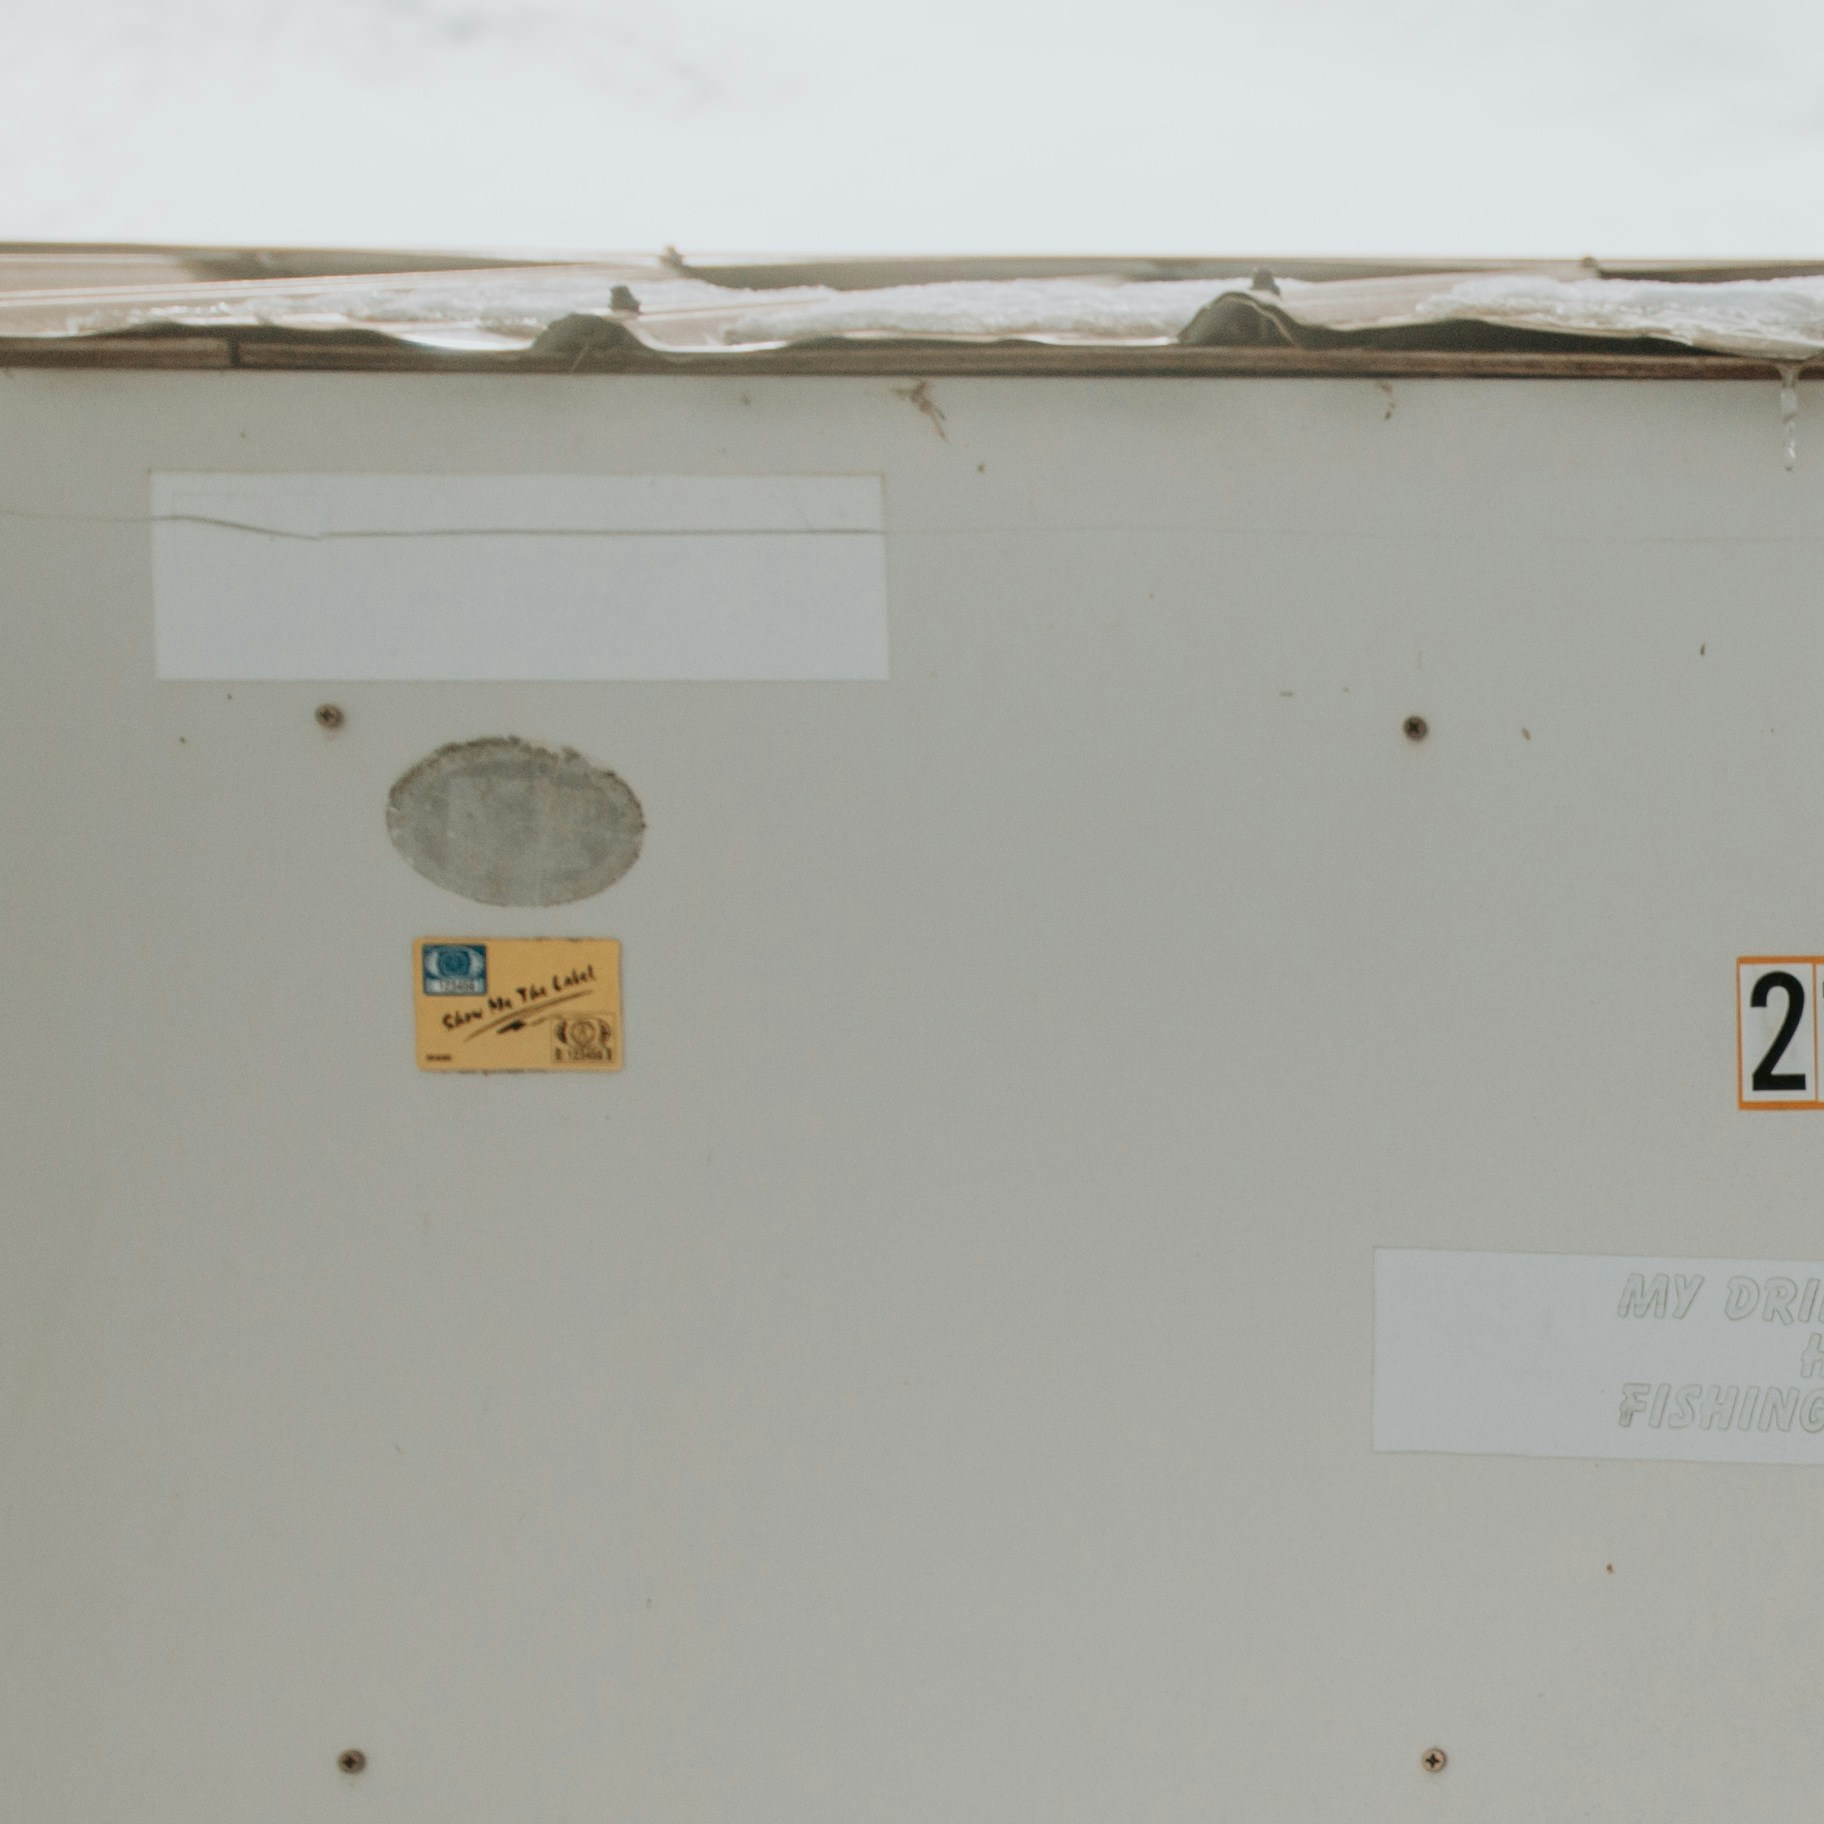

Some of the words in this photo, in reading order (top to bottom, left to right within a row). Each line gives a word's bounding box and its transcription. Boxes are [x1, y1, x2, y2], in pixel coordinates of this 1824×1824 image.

[442, 1011, 482, 1031] Show
[487, 997, 513, 1017] Me
[516, 985, 548, 1004] The
[551, 963, 597, 992] Label
[1617, 1273, 1704, 1319] MY
